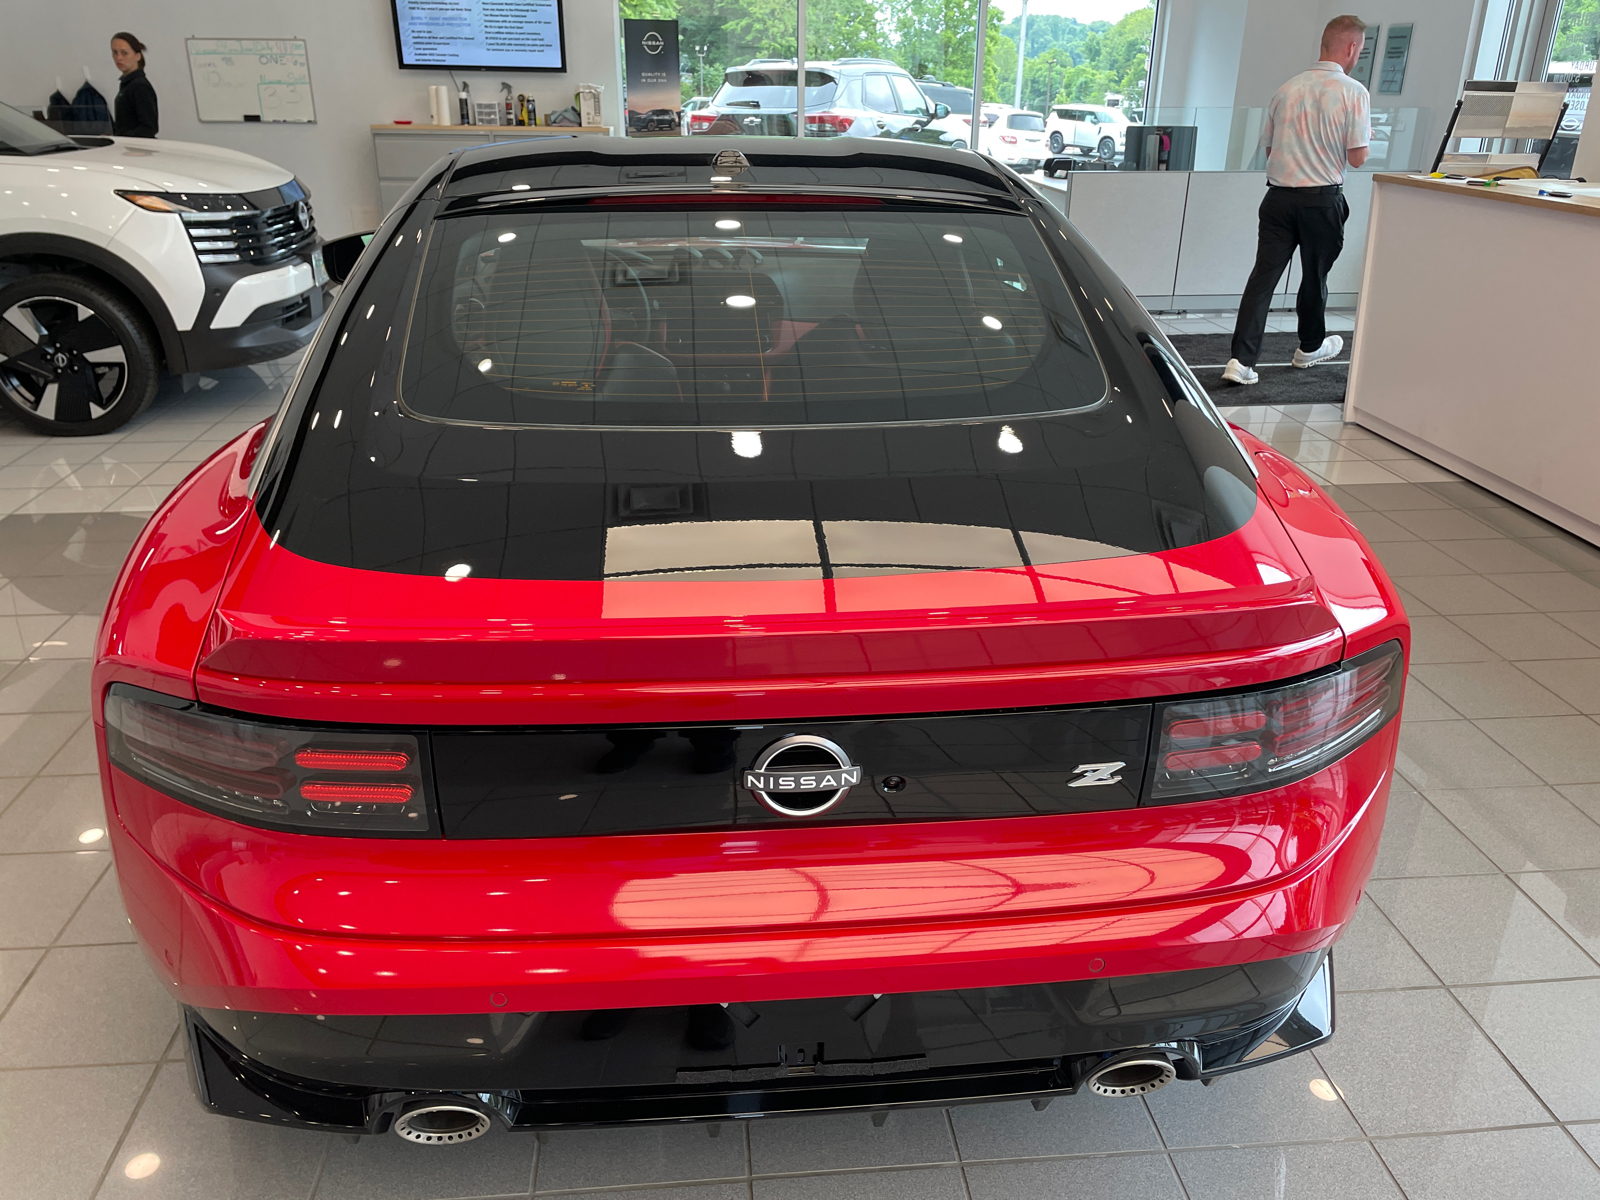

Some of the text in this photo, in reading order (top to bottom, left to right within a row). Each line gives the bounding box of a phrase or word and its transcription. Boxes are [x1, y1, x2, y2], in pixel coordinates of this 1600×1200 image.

[259, 54, 287, 66] ONE
[747, 770, 857, 789] NISSAN
[1067, 761, 1127, 788] Z
